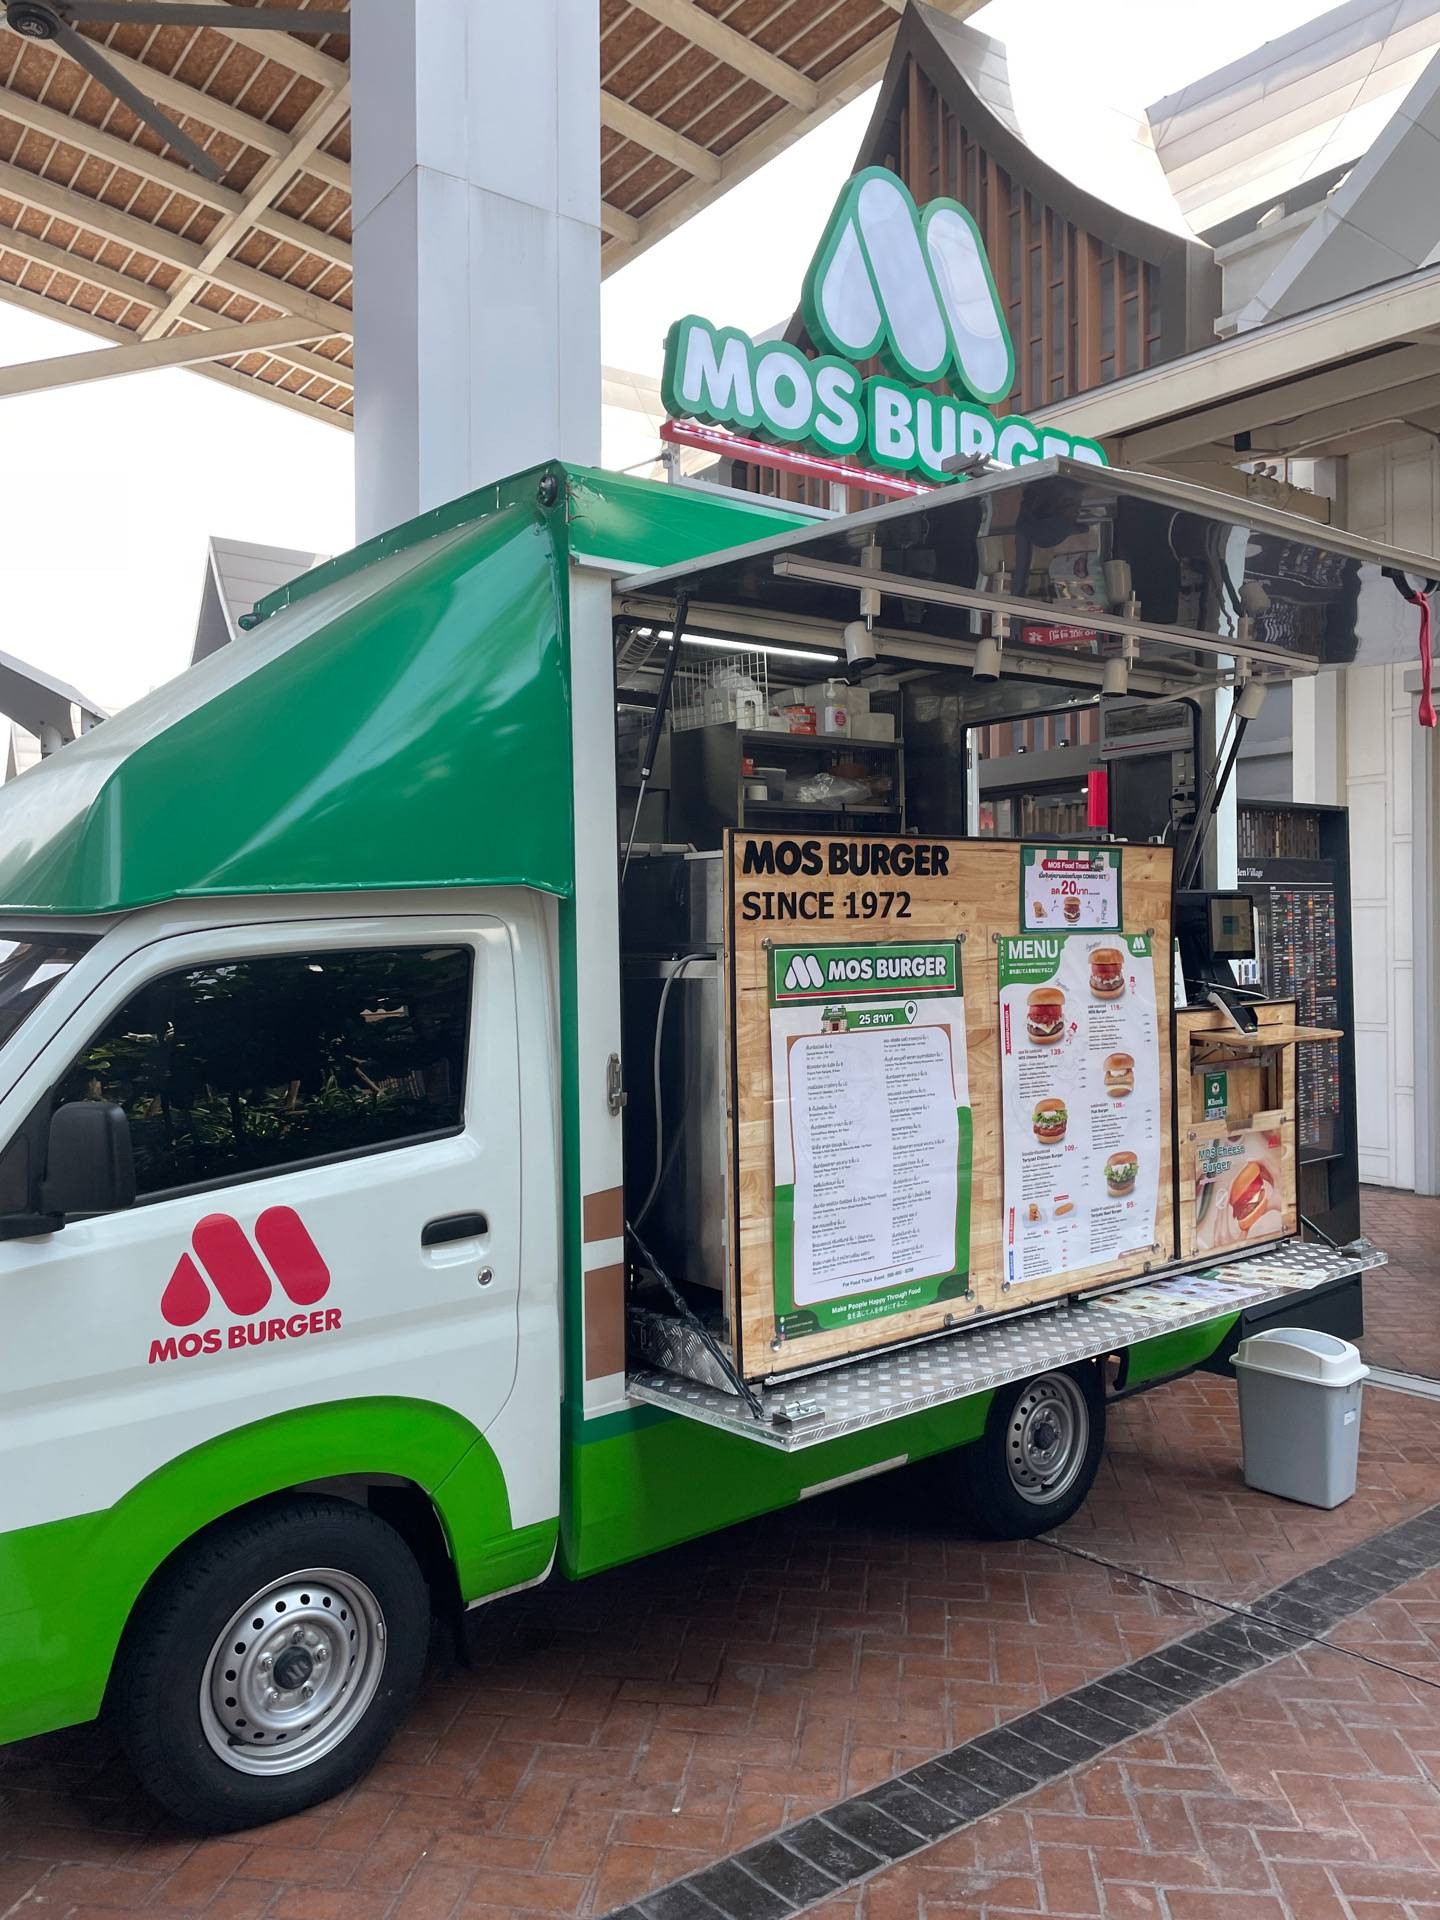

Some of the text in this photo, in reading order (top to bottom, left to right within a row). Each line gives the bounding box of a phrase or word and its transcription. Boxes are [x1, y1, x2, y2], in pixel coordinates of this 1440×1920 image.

[681, 326, 860, 445] MOS
[742, 840, 950, 877] MOS BURGER
[1047, 861, 1061, 869] MOS
[1061, 861, 1075, 869] Food
[1061, 880, 1077, 895] 20
[742, 890, 912, 921] SINCE 1972
[1008, 939, 1059, 960] MENU
[828, 954, 948, 982] MOS BURGER
[859, 1013, 894, 1025] 25 สาขา
[1198, 1144, 1246, 1160] MOS Cheese
[1202, 1160, 1232, 1174] Burger
[832, 1287, 922, 1314] Make People Happy Through Food
[148, 1308, 342, 1365] MOS BURGER
